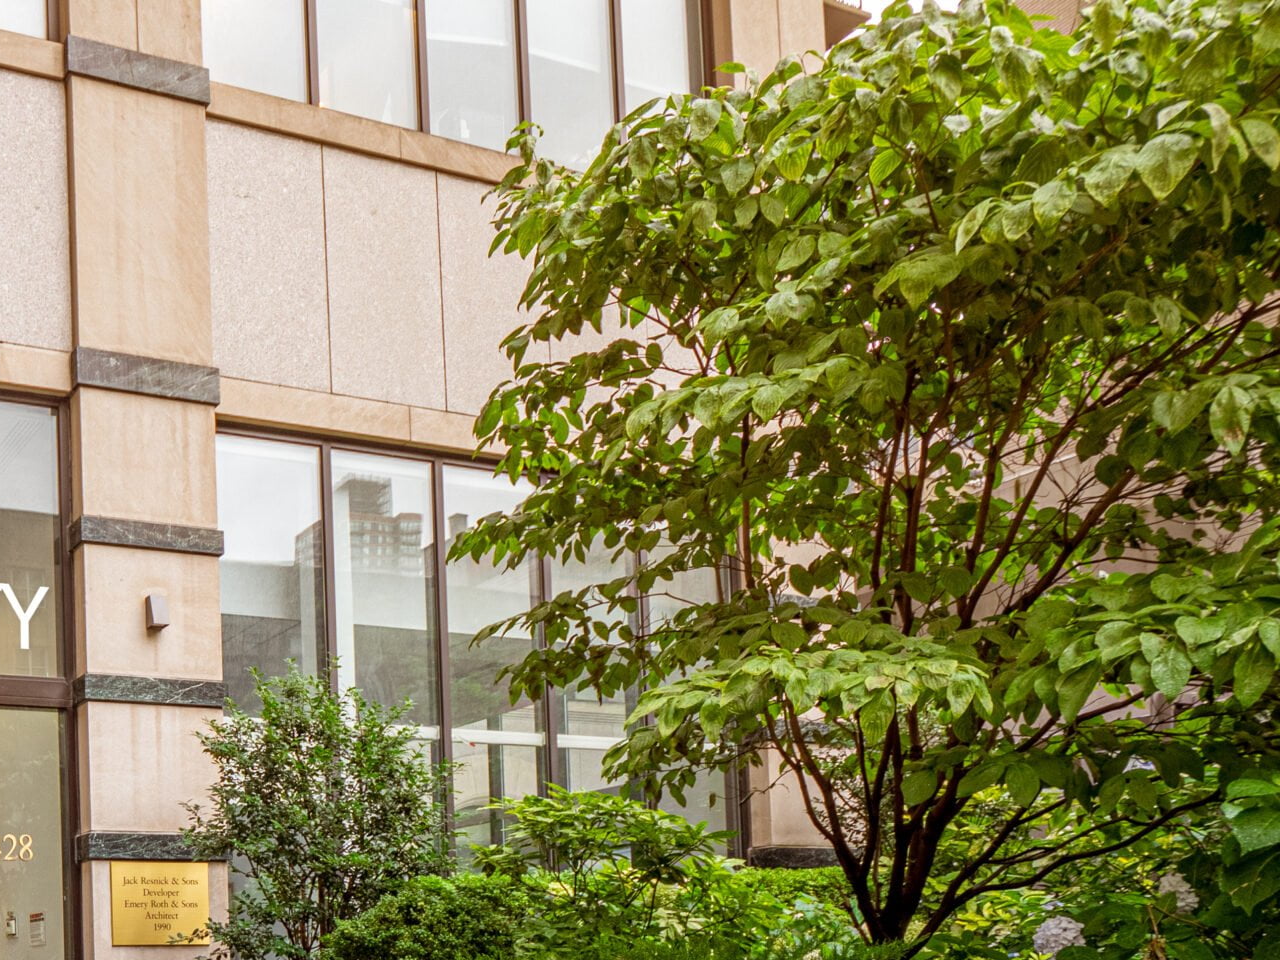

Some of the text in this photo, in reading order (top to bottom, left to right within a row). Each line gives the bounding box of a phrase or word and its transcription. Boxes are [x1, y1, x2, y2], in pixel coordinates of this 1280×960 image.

[123, 876, 199, 886] Jack Resnick & Sons
[143, 888, 180, 898] Developer
[124, 900, 148, 909] Emery
[151, 900, 169, 908] Roth
[145, 911, 179, 920] Architect
[154, 922, 172, 931] 1990
